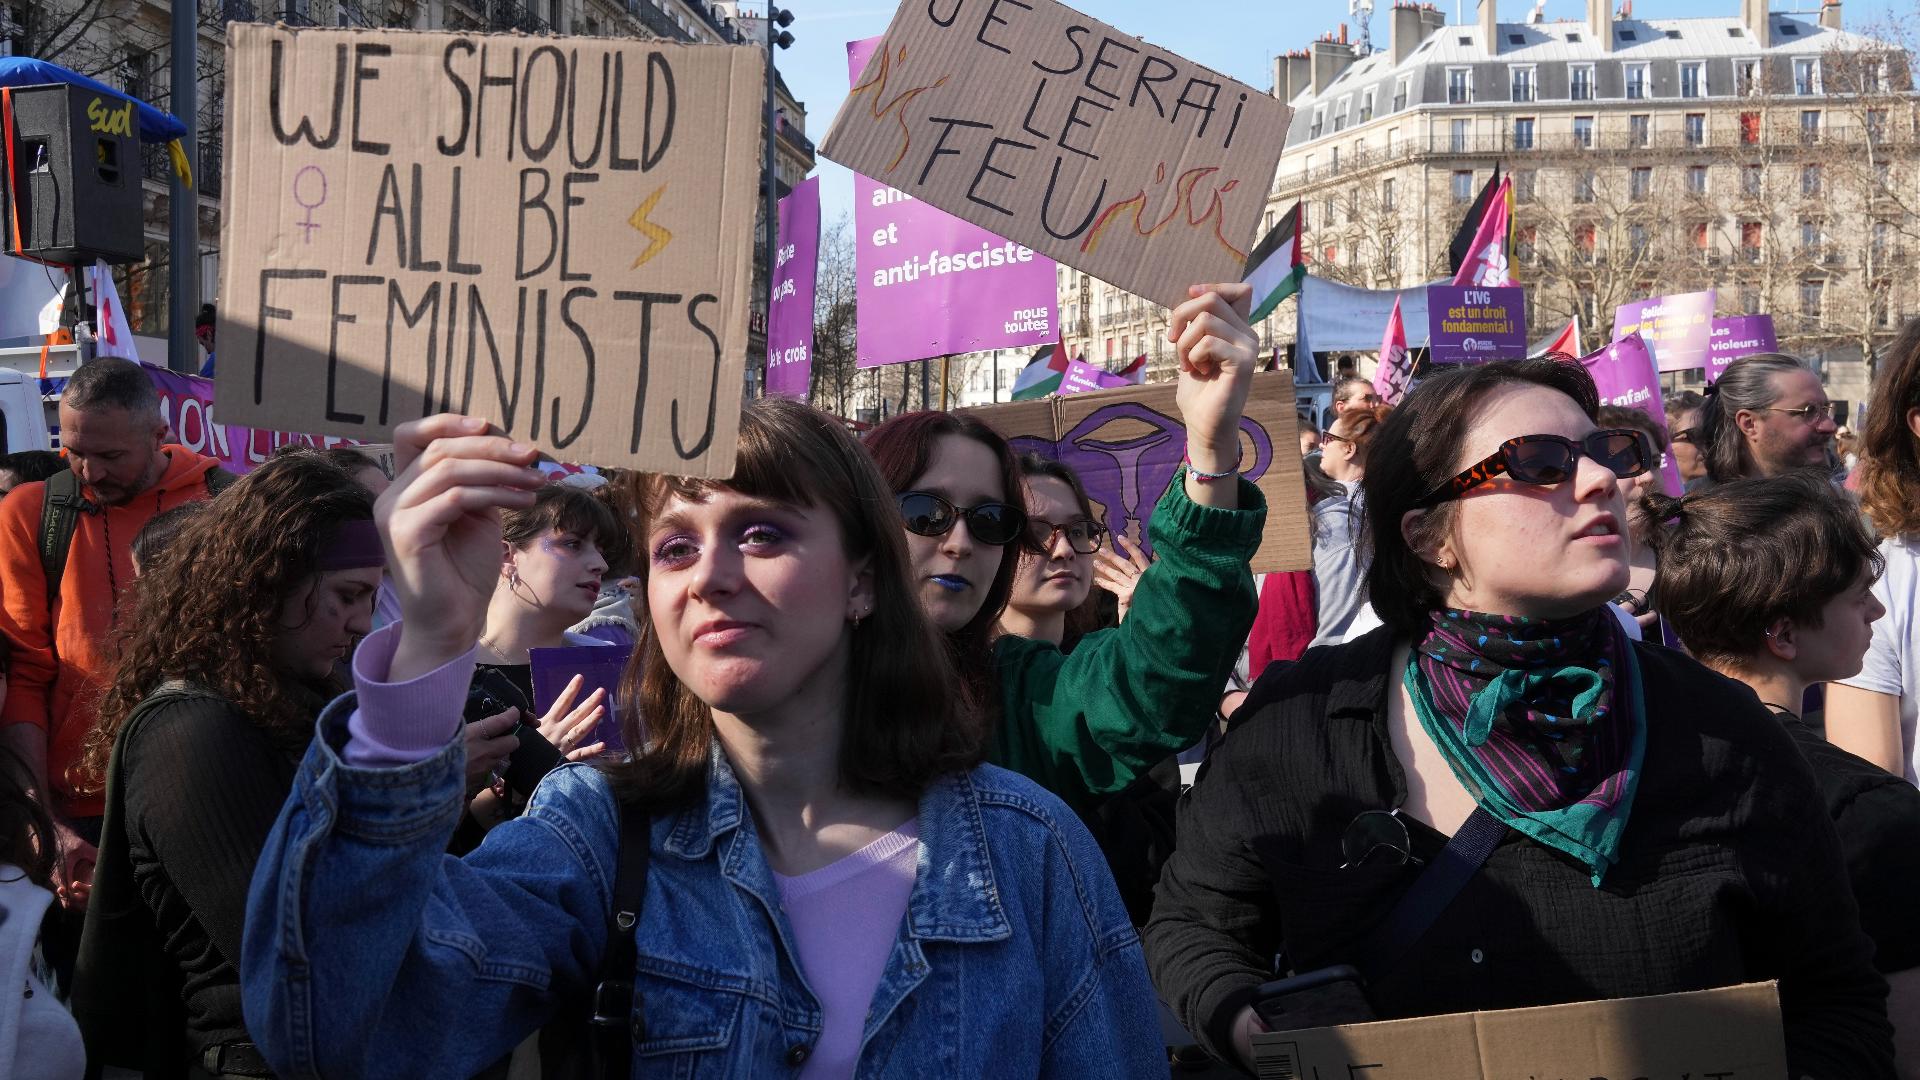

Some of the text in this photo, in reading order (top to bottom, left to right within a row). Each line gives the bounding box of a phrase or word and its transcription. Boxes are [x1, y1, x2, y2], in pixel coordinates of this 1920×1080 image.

[87, 97, 132, 137] Sud
[270, 38, 677, 172] WE SHOULD
[1022, 78, 1115, 160] LE
[917, 117, 1108, 241] FEU
[365, 163, 600, 281] ALL BE
[872, 222, 898, 246] et
[873, 241, 1034, 287] anti-fasciste
[1464, 290, 1491, 305] L'IVG
[1013, 307, 1048, 321] nous
[1448, 306, 1507, 319] est un droit
[1004, 319, 1049, 334] toutes
[1441, 320, 1508, 334] fondamental
[1711, 327, 1730, 337] Les
[784, 340, 807, 364] crois
[1711, 337, 1759, 351] violeurs
[253, 268, 721, 461] FEMINISTS
[1711, 354, 1732, 366] ton
